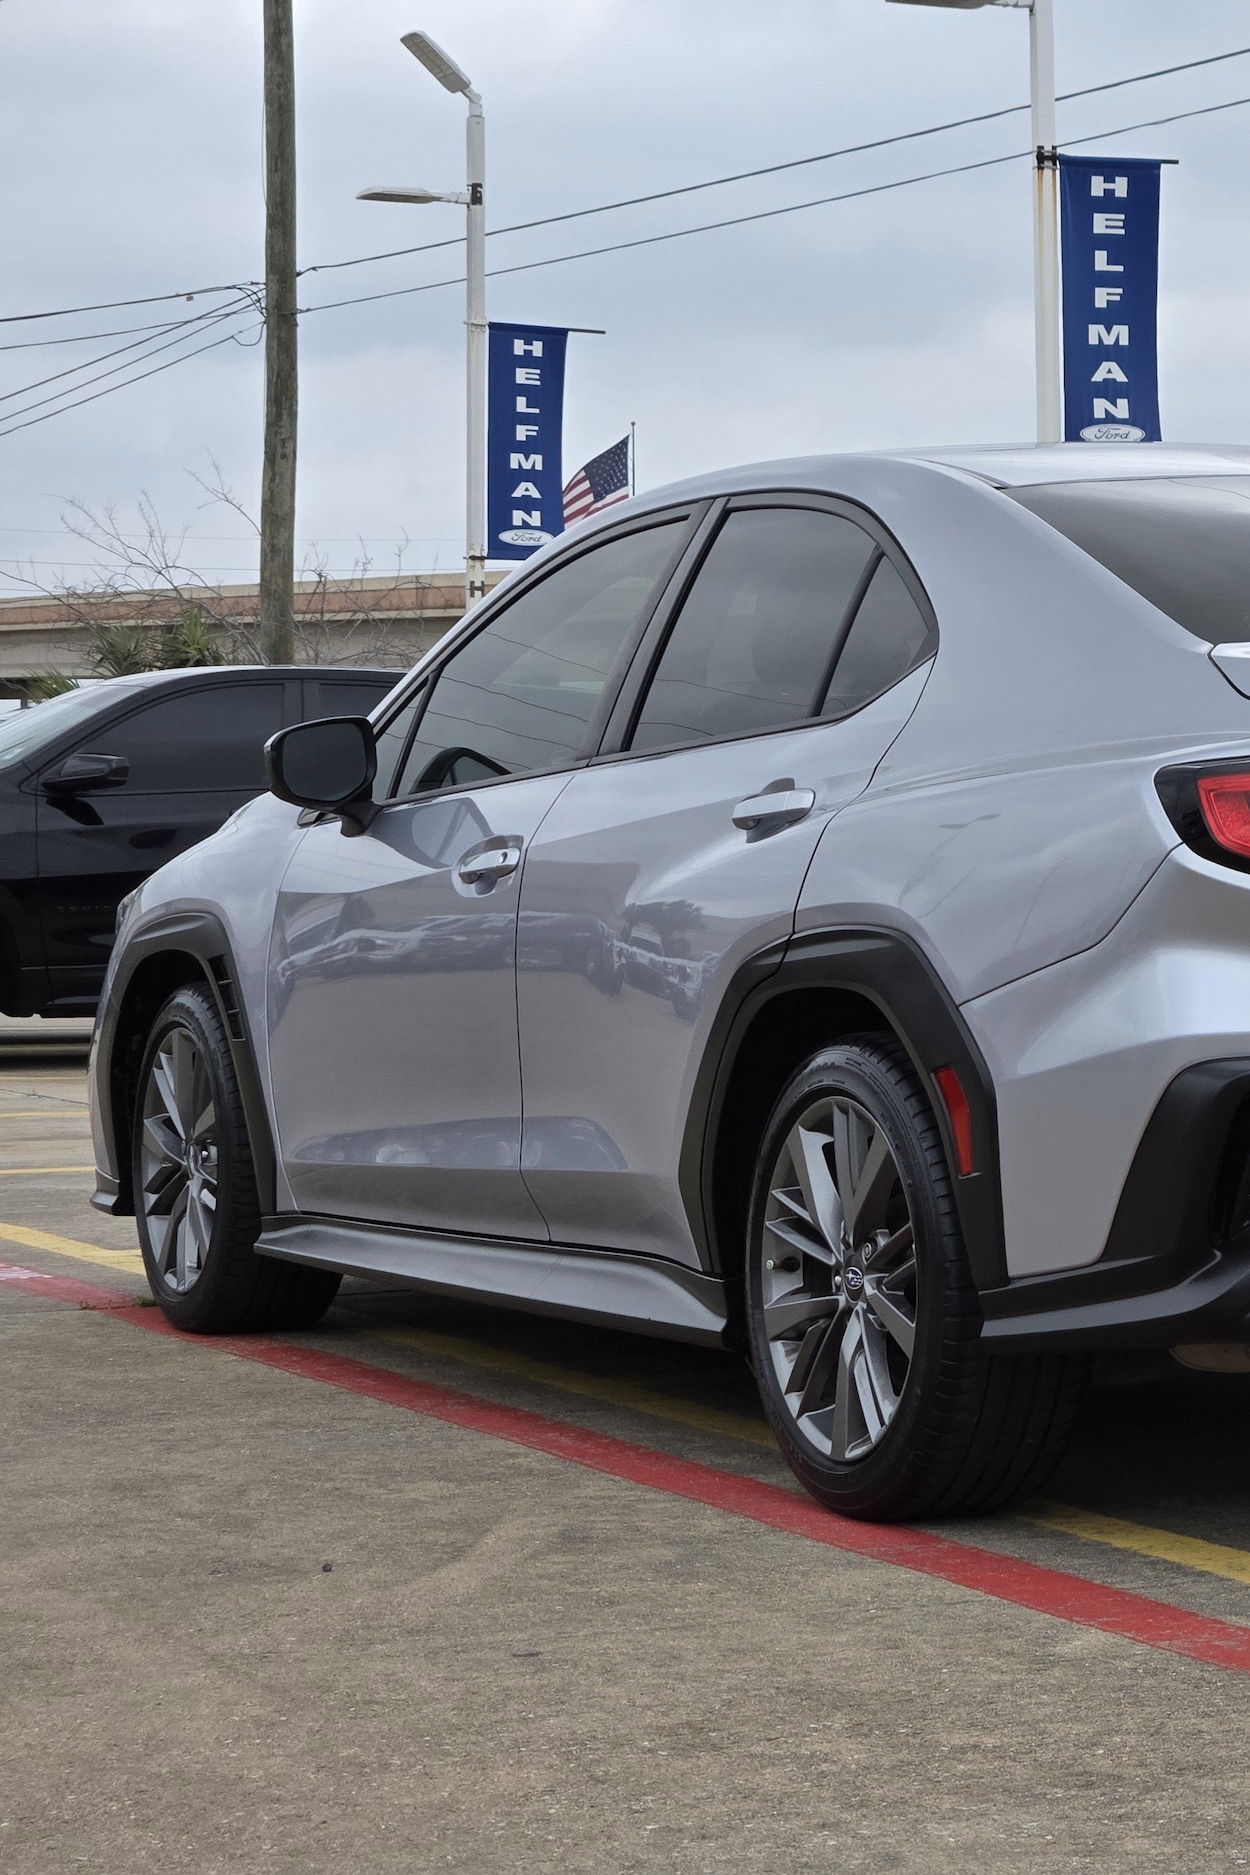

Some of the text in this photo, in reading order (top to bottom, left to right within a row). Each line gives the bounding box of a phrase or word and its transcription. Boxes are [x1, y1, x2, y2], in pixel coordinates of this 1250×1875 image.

[1088, 175, 1130, 419] HELFMAN
[509, 338, 543, 527] HELFMAN
[1094, 427, 1132, 441] Ford
[511, 532, 543, 544] Ford
